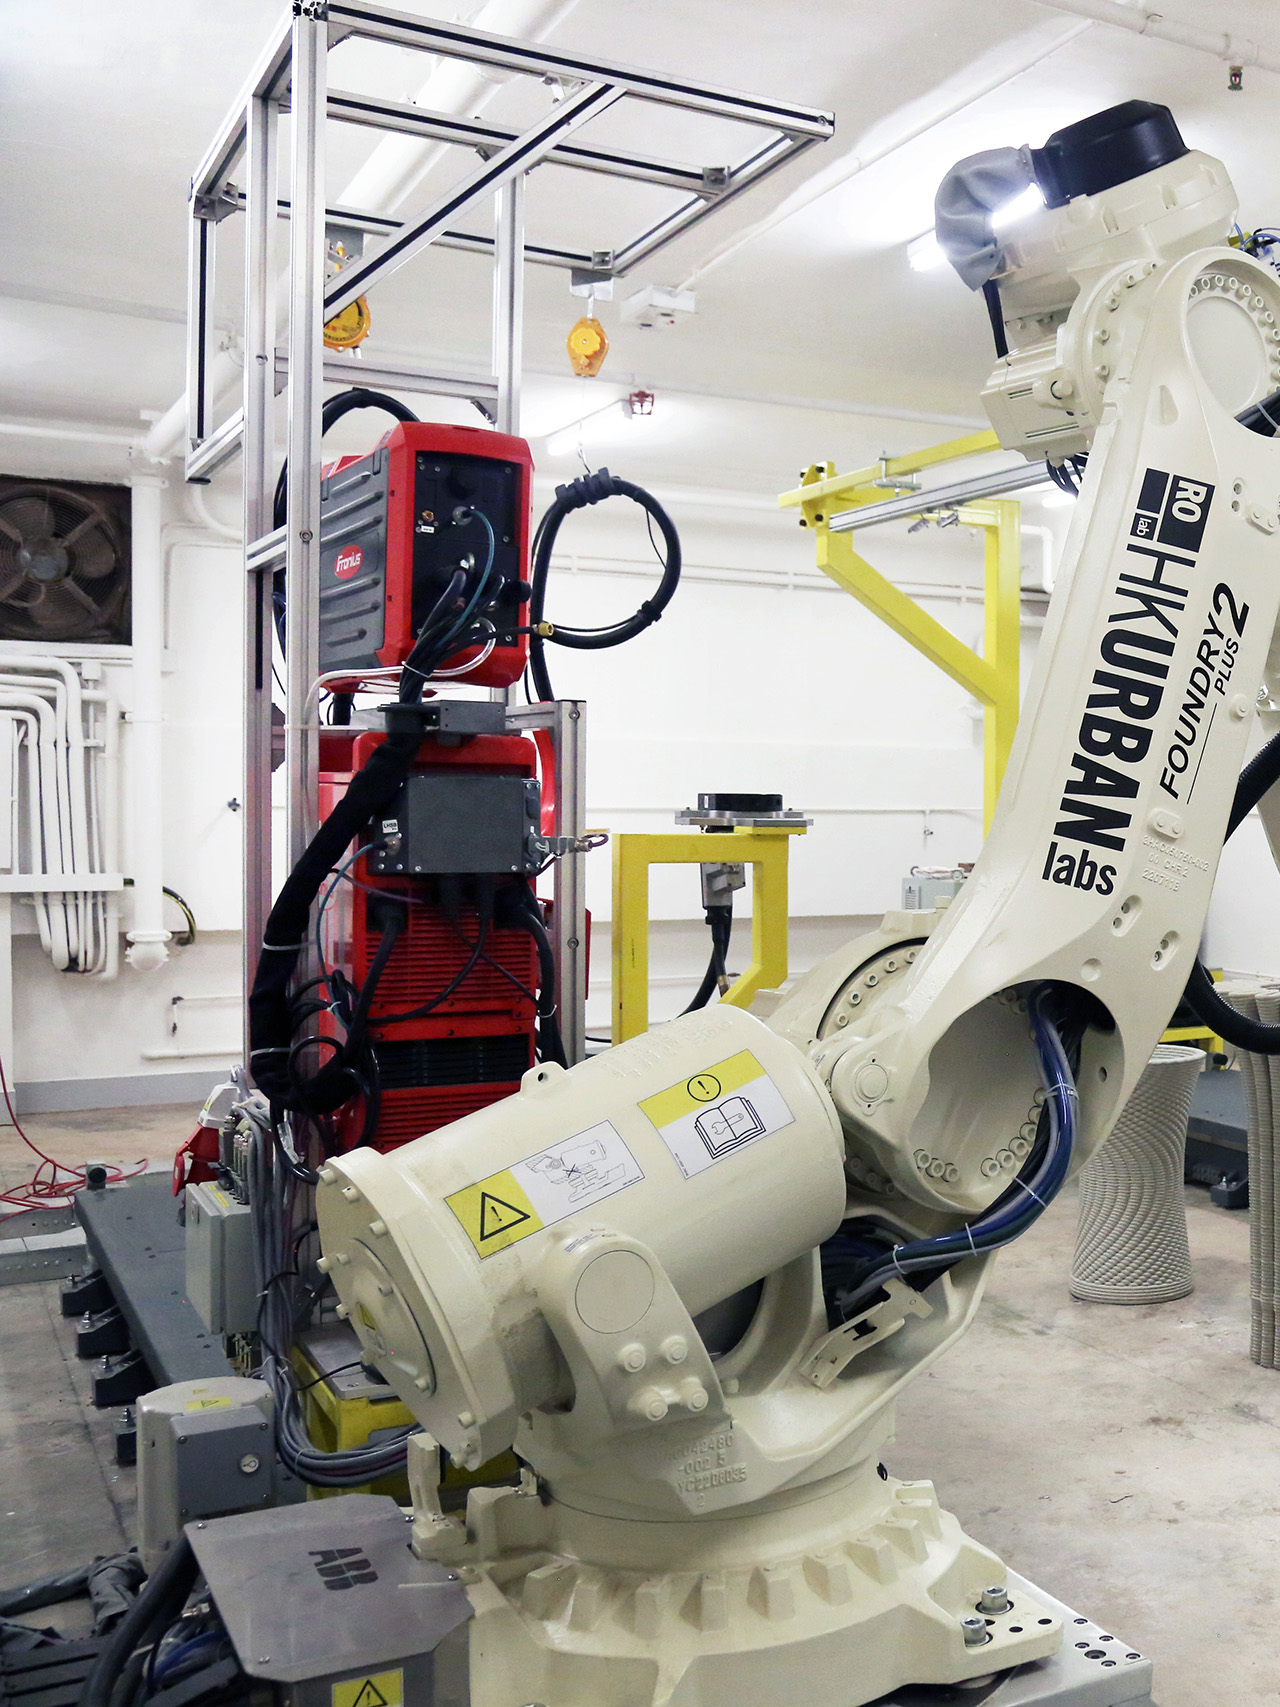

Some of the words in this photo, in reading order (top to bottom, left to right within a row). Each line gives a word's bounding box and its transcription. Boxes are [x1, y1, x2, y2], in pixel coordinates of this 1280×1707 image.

[1172, 480, 1208, 523] RO
[1136, 517, 1152, 536] lab
[336, 552, 362, 573] Fronius
[1159, 622, 1226, 799] FOUNDRY
[1212, 582, 1249, 638] 2
[1215, 637, 1239, 696] PLUS
[1054, 543, 1195, 851] HKURBAN
[1041, 841, 1118, 895] labs
[308, 1547, 379, 1591] ABB
